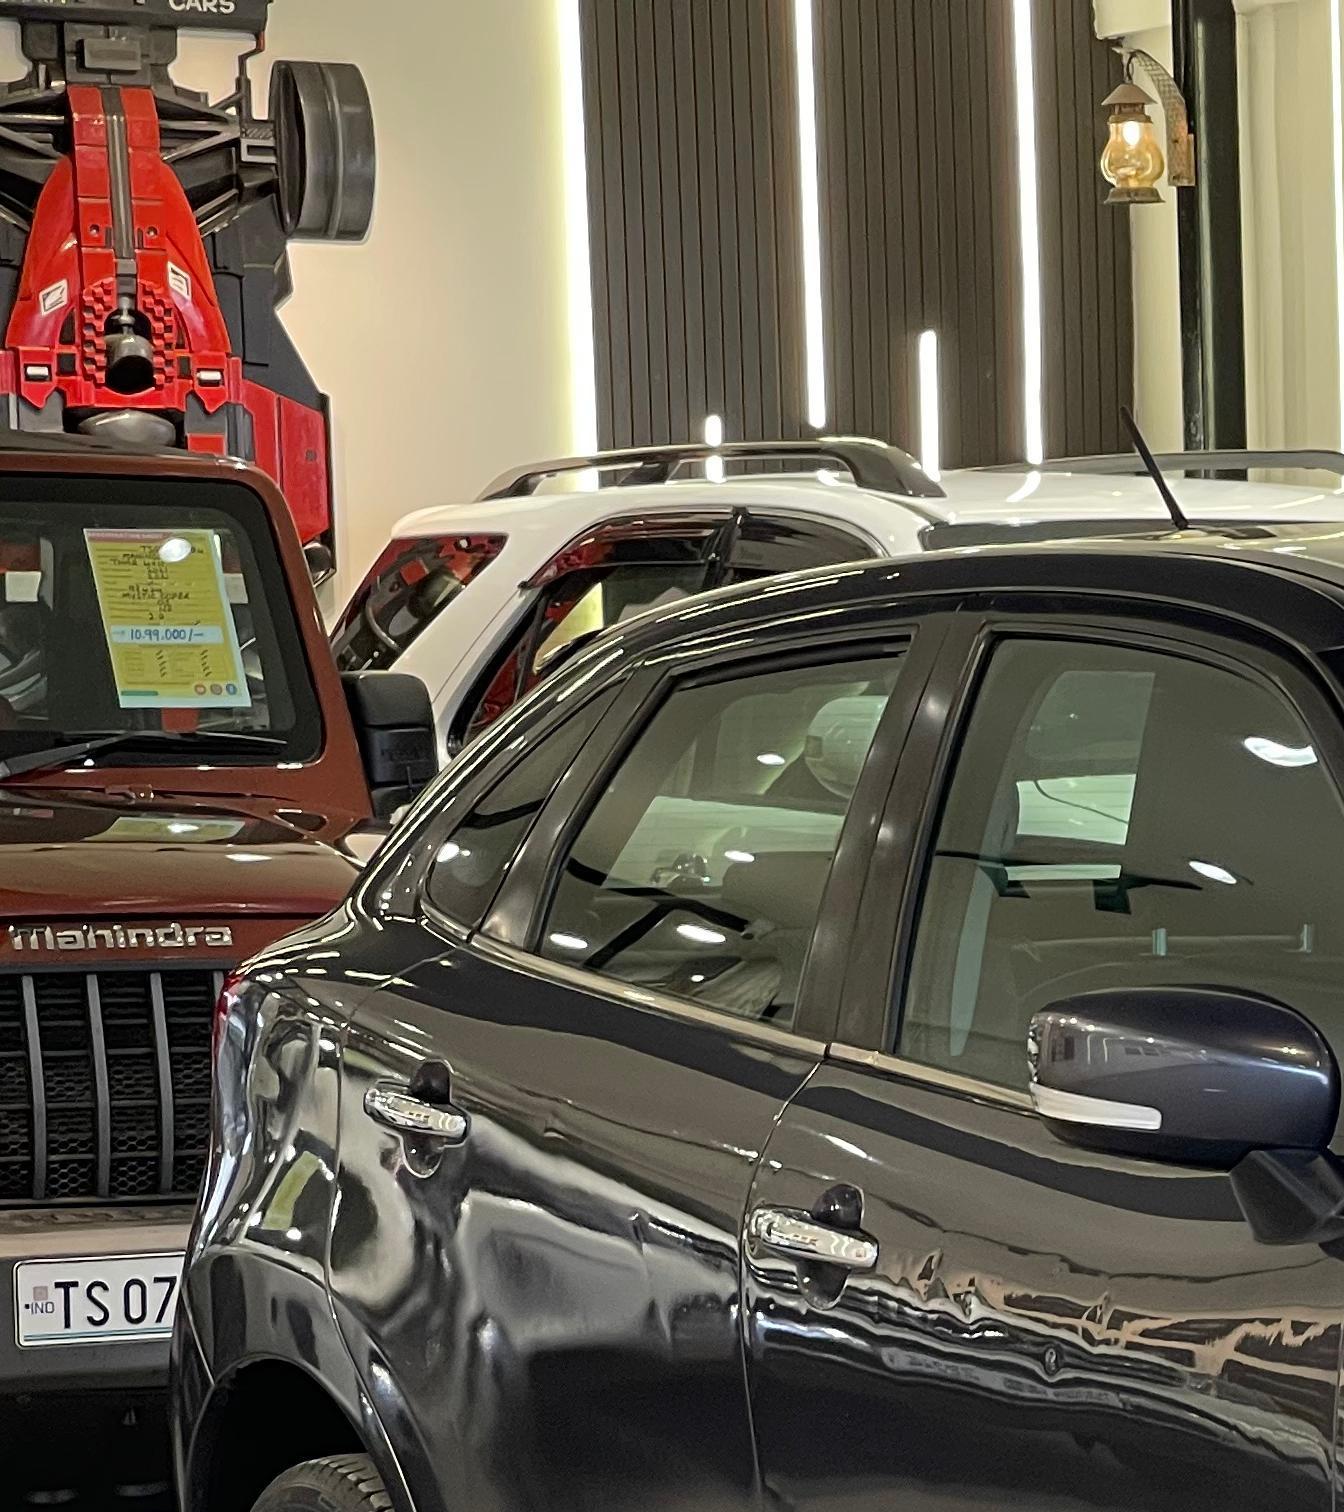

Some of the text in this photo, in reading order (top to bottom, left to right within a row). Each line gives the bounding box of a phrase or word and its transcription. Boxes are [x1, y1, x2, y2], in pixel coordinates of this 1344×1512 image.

[31, 1301, 55, 1314] IND
[54, 1275, 177, 1329] TS 07
